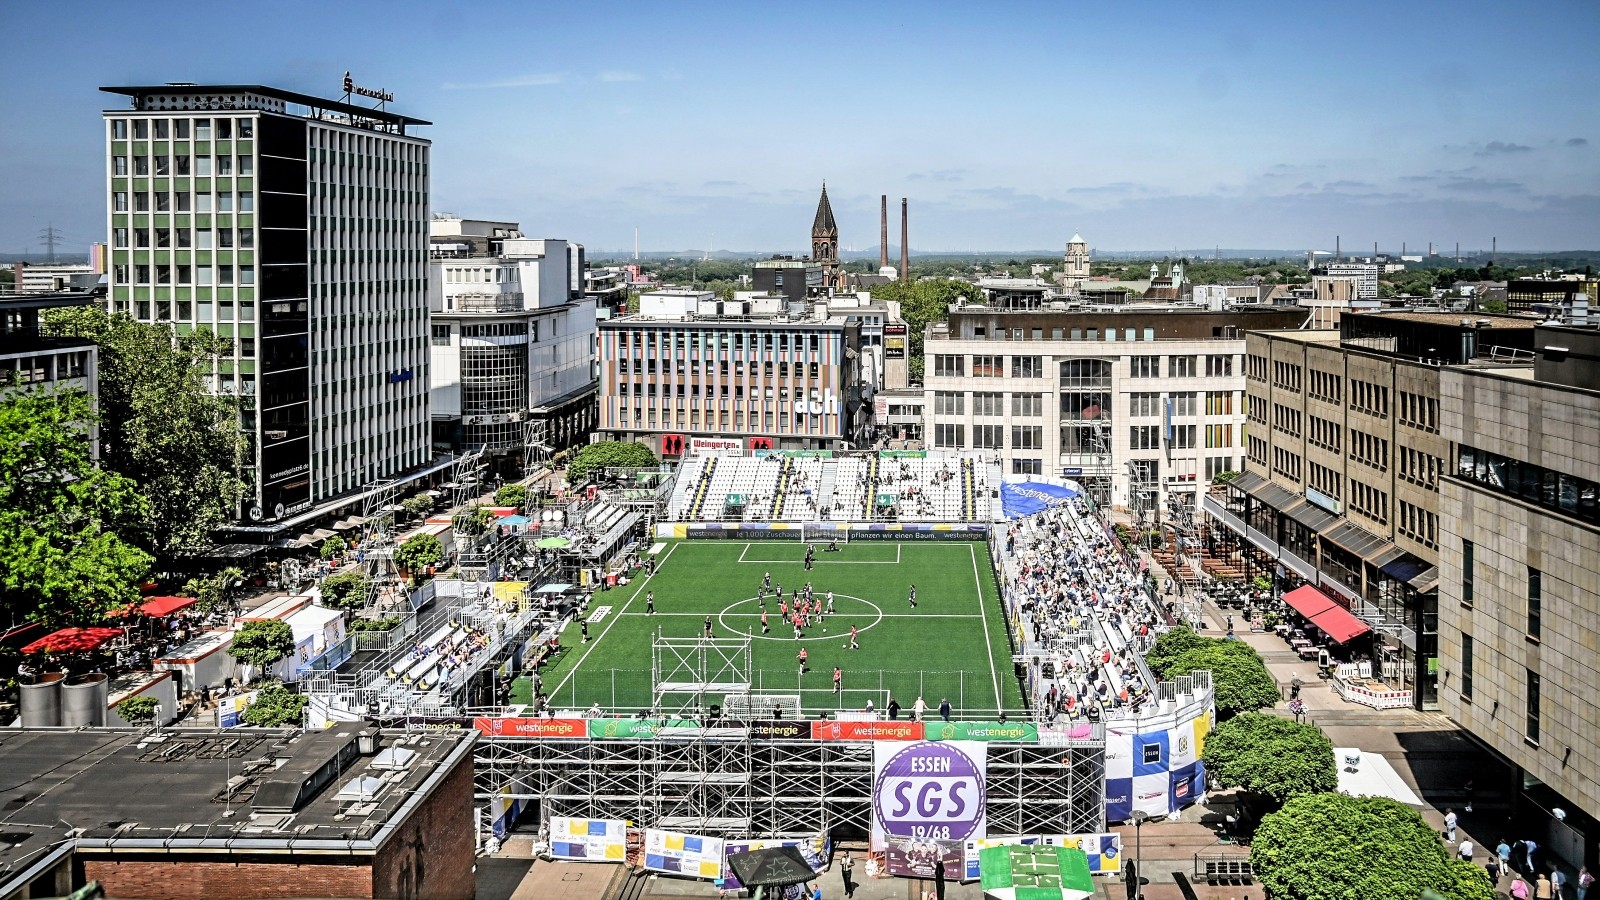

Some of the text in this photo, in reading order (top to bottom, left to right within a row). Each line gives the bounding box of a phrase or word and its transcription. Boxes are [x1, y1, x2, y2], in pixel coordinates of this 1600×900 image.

[693, 440, 736, 450] Weingarten
[944, 532, 983, 540] westenergie
[516, 719, 573, 734] westenergie
[750, 721, 798, 736] estenergie
[854, 722, 912, 738] westenergie
[966, 722, 1025, 738] westenergie
[911, 756, 951, 773] ESSEN
[892, 780, 967, 818] SGS
[910, 825, 950, 839] 19/68
